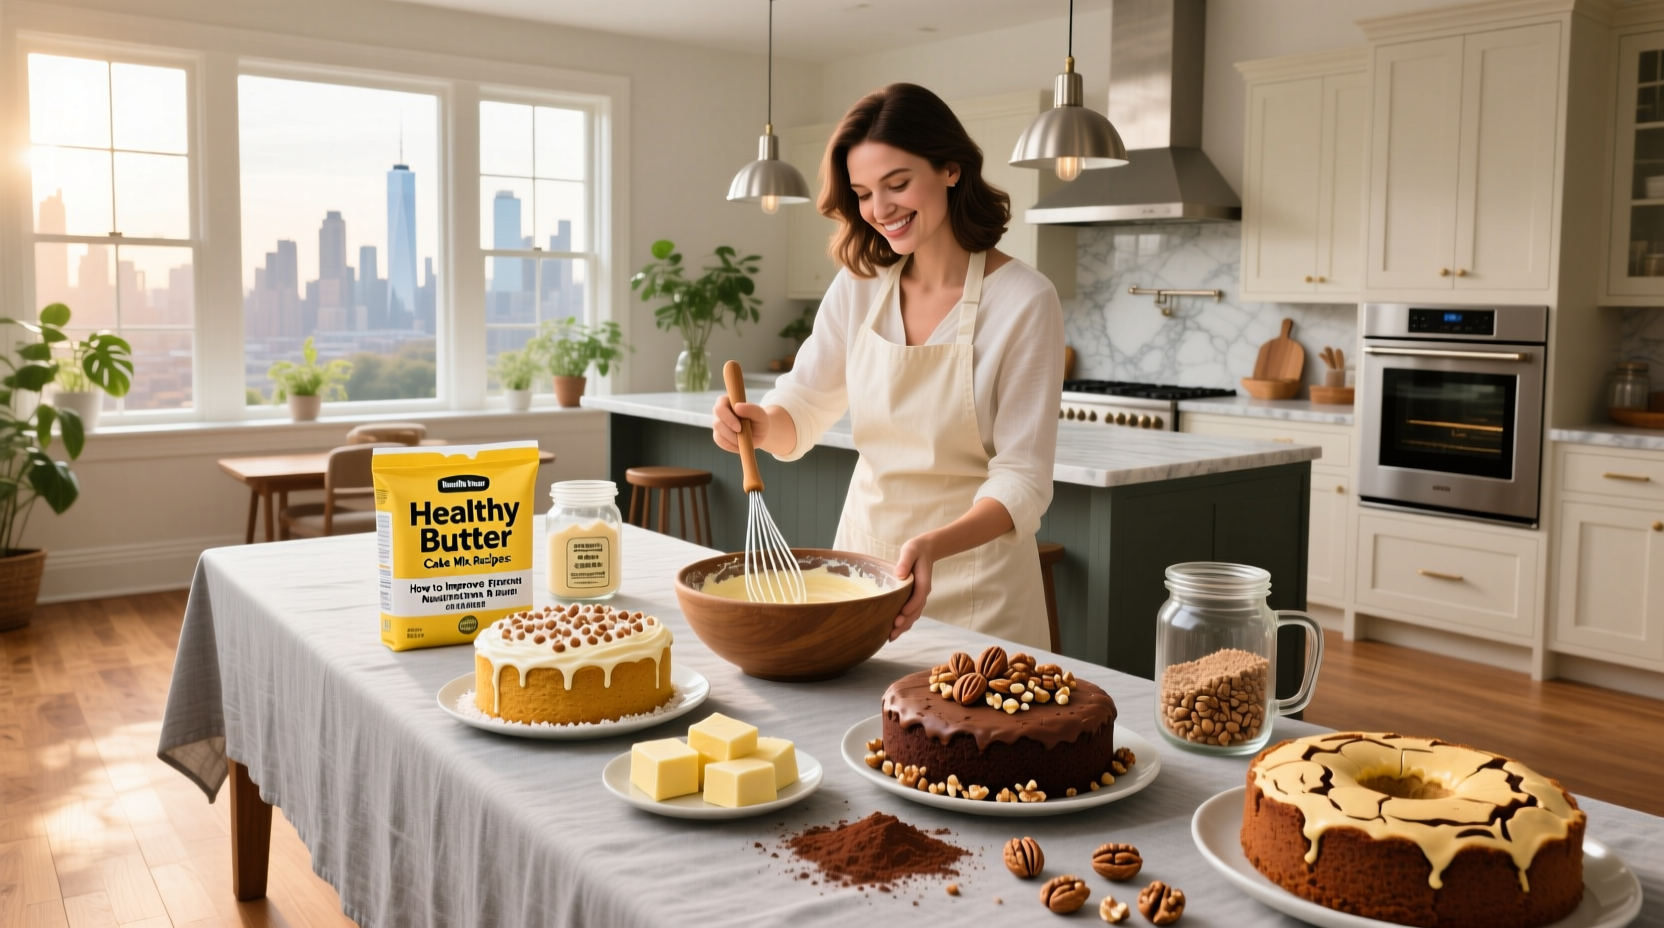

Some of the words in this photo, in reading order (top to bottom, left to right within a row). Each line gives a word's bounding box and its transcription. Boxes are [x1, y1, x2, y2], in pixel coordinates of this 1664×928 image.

[410, 497, 520, 528] Healthy
[421, 527, 512, 553] Butter
[410, 583, 431, 594] How
[433, 584, 443, 593] to
[445, 580, 485, 592] Improve
